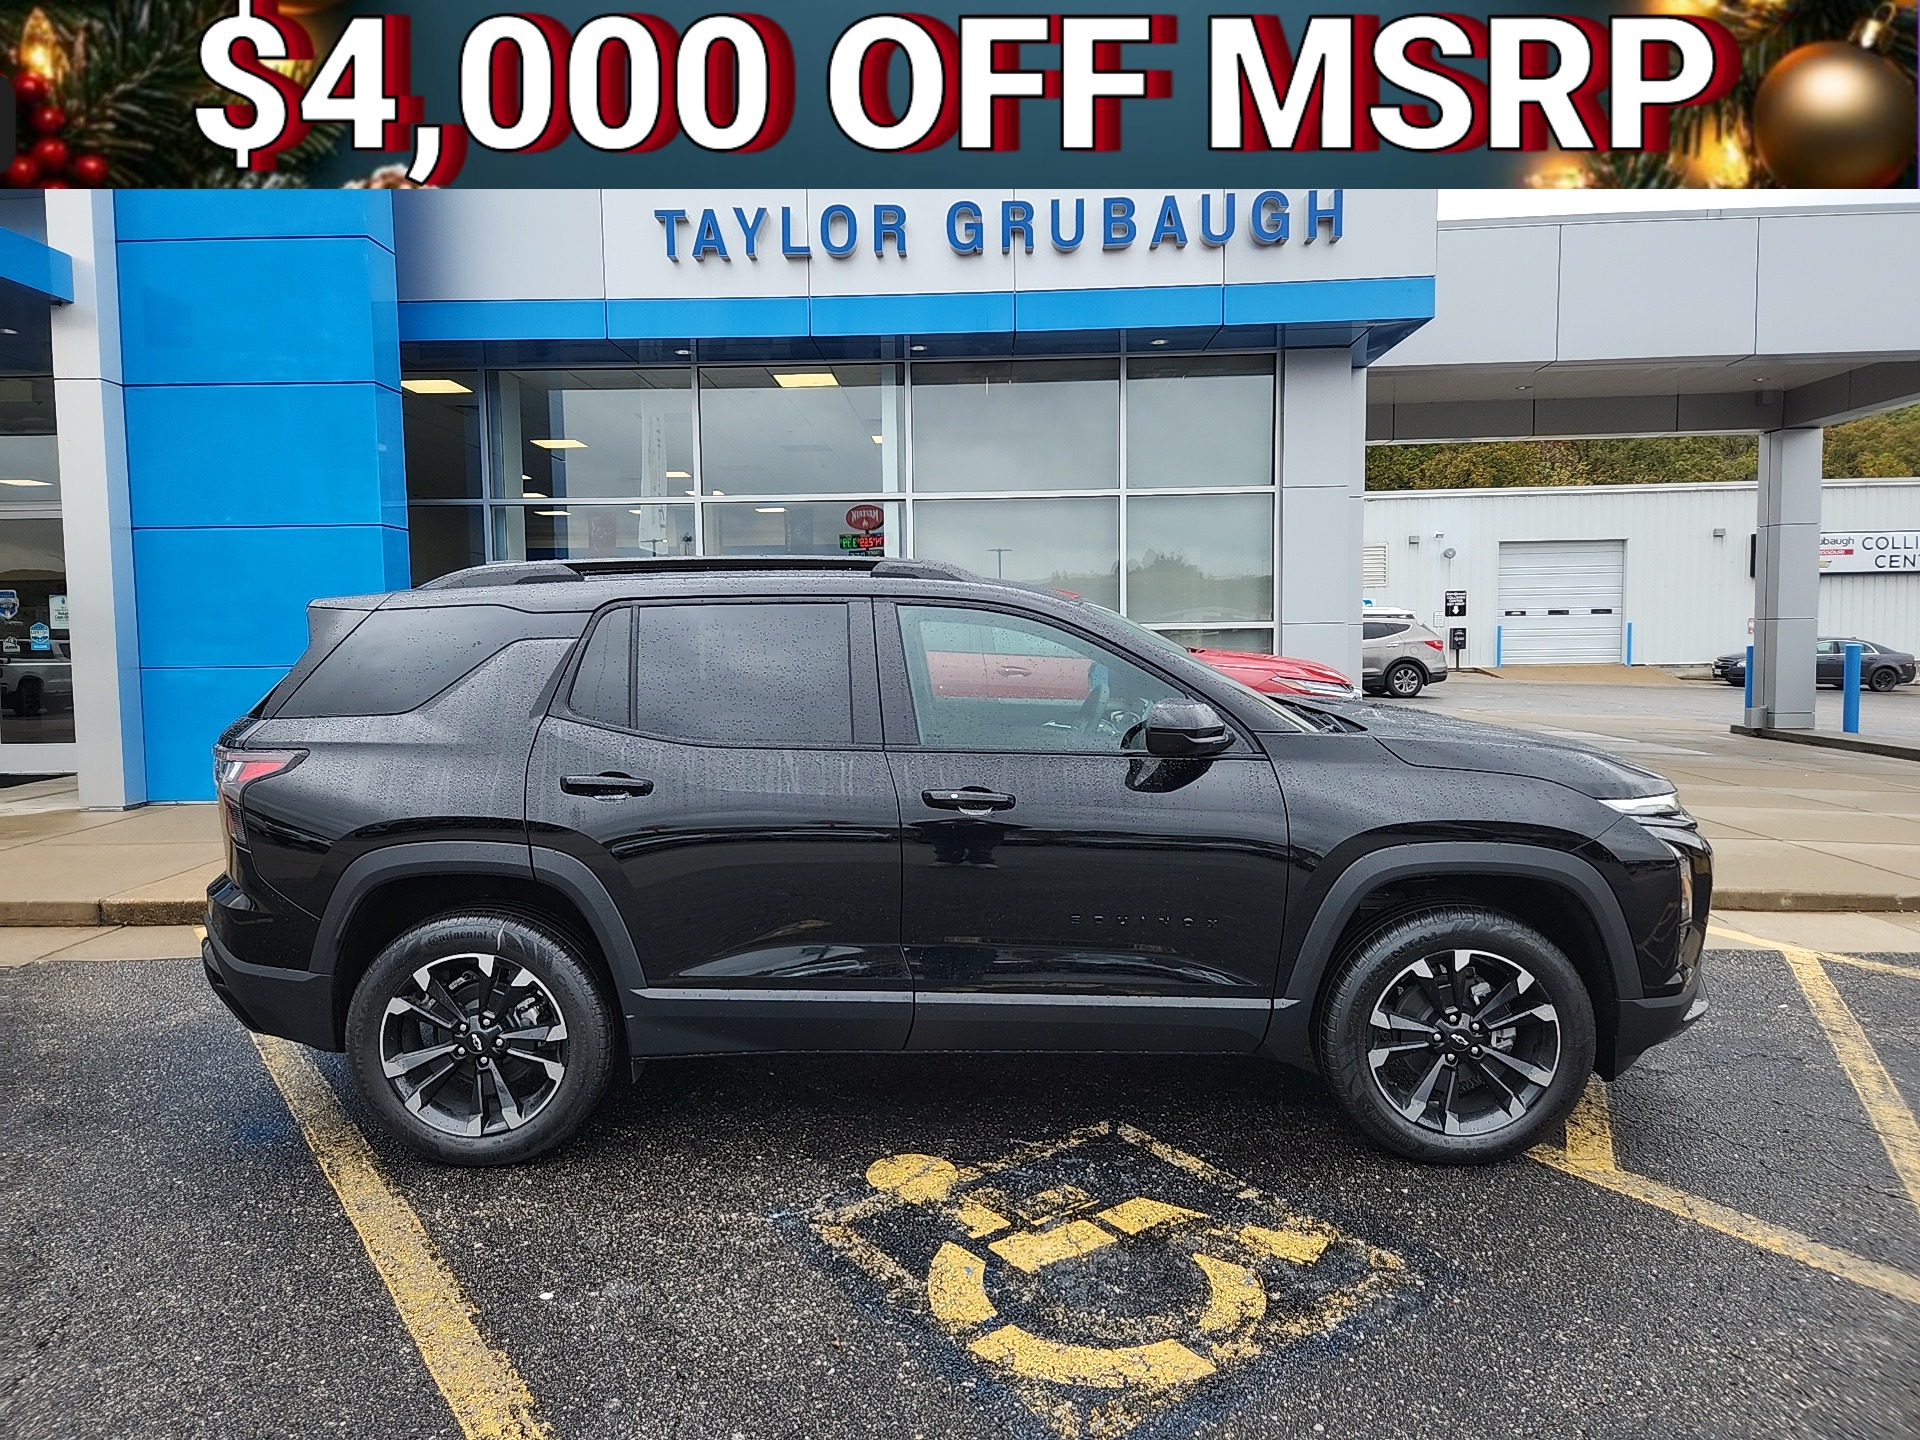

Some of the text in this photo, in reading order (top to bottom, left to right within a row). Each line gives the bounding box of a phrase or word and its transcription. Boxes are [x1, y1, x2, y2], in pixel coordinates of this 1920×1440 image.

[653, 188, 1344, 262] TAYLOR GRUBAUGH
[1861, 535, 1919, 551] COLLI
[1874, 553, 1920, 569] CEN
[427, 930, 488, 947] Continental
